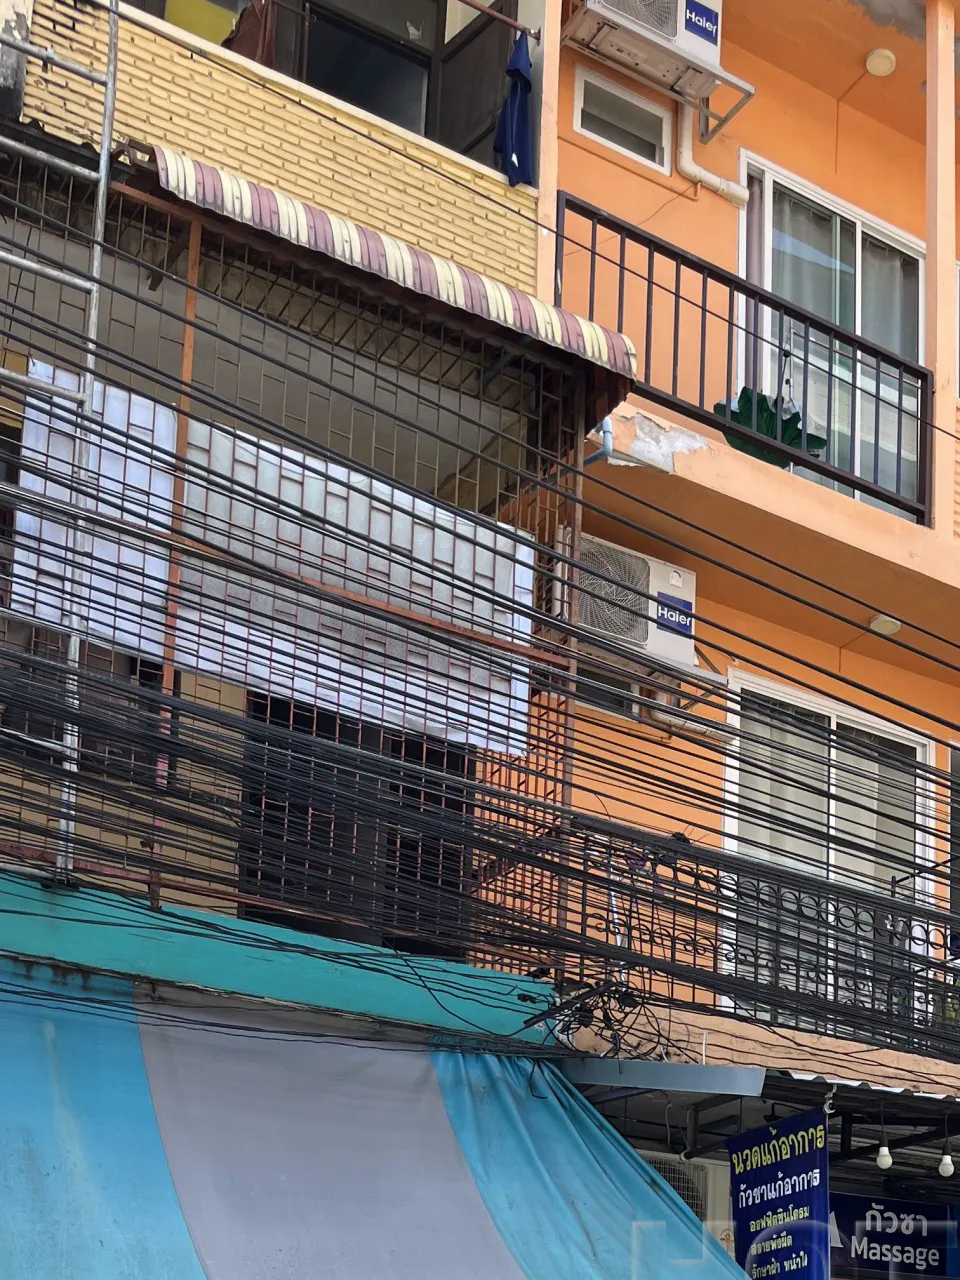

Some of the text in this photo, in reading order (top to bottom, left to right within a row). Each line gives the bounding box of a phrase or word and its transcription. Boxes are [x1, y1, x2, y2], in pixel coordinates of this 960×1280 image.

[686, 8, 718, 37] Haier
[658, 605, 691, 626] Haier
[732, 1124, 825, 1174] นวดแก้อาการ
[865, 1202, 928, 1236] กัวซา
[850, 1235, 940, 1270] Massage
